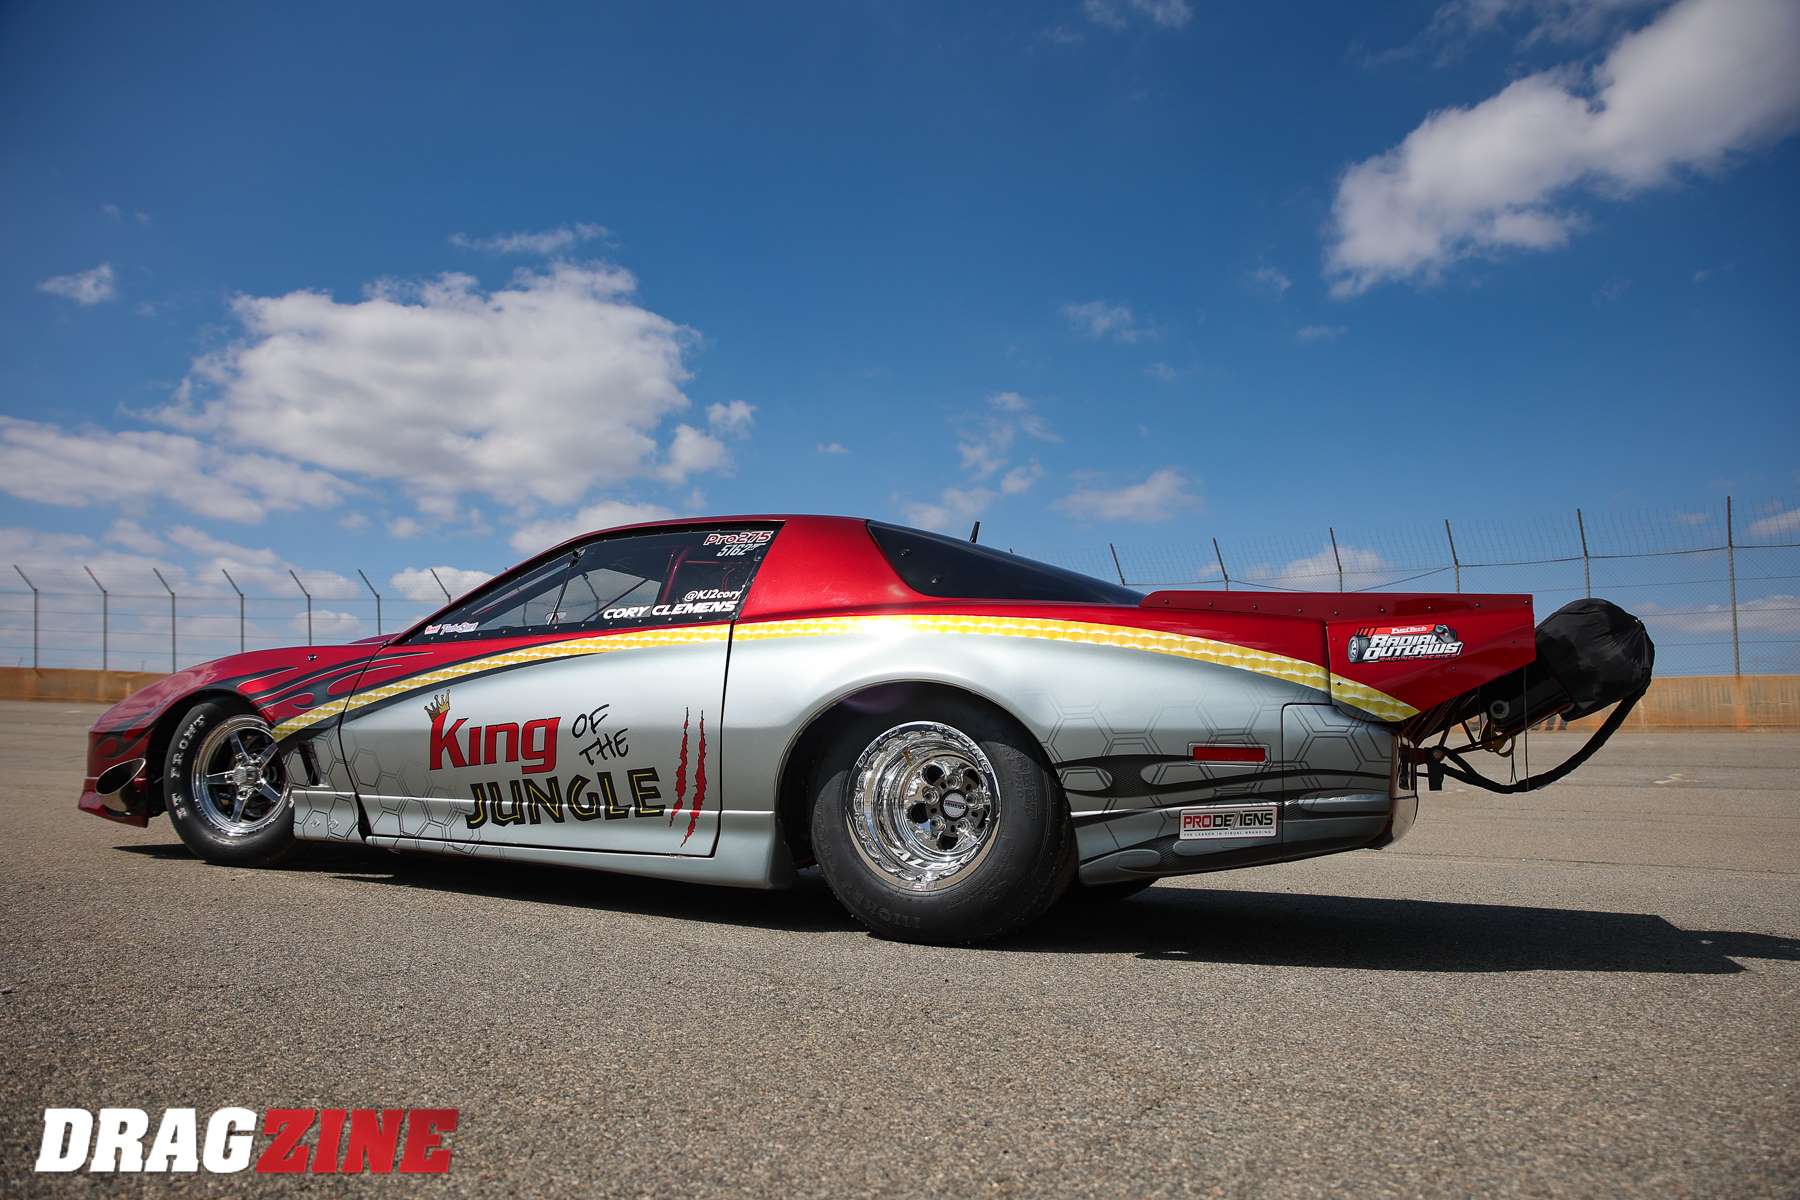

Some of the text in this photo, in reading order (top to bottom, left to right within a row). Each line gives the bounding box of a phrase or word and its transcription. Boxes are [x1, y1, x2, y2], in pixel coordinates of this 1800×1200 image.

[703, 531, 774, 546] Pro275
[603, 600, 738, 619] CORY CLEMENS
[1362, 641, 1463, 661] OUTLAWS
[1370, 633, 1440, 648] RADIAL
[571, 703, 610, 738] OF
[170, 714, 205, 778] FRONT
[430, 708, 561, 775] King
[579, 727, 628, 765] THE
[465, 766, 666, 829] JUNGLE
